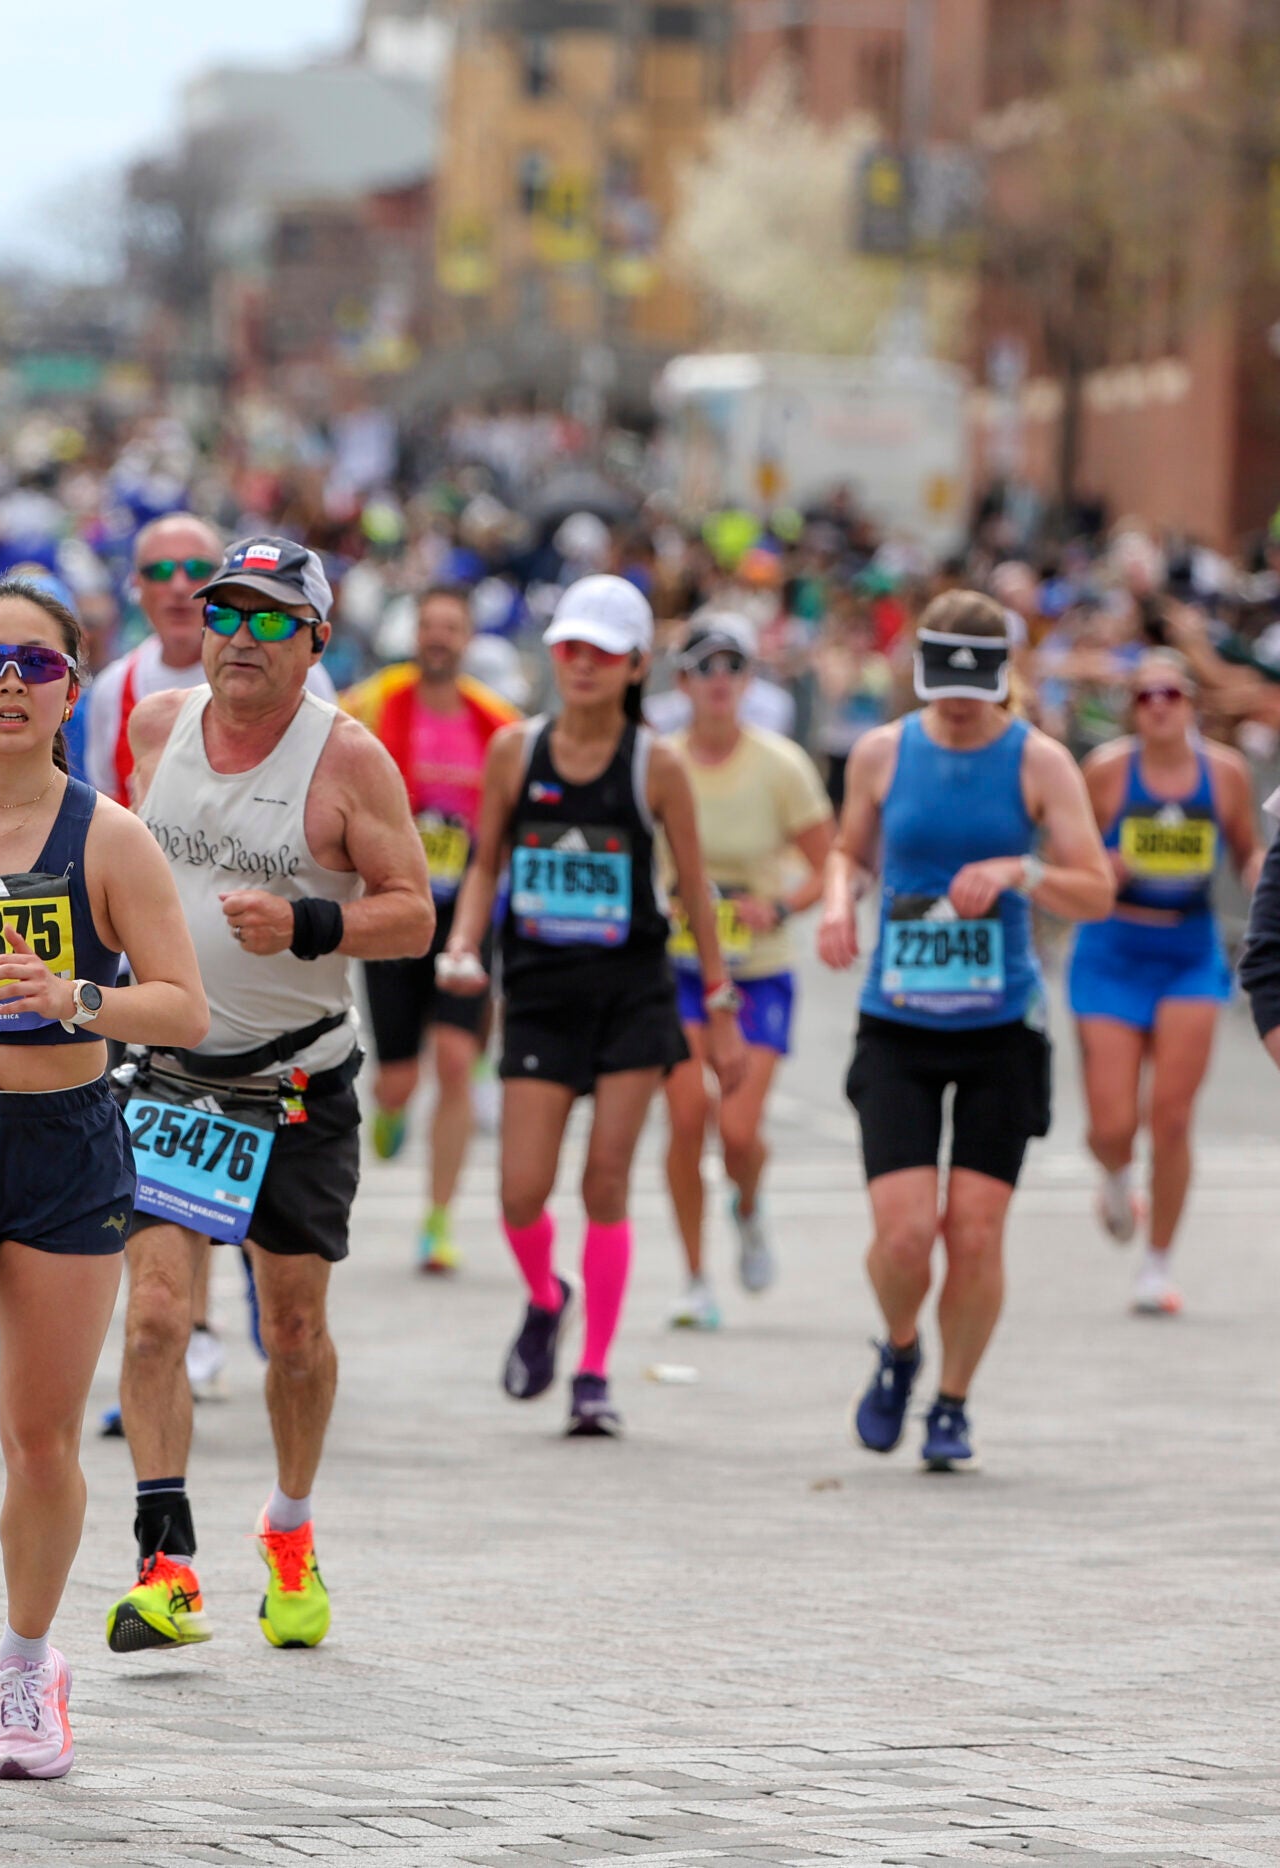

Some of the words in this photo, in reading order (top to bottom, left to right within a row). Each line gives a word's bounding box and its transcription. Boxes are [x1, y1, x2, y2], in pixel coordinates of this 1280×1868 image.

[248, 549, 277, 558] TEXAS
[220, 836, 300, 884] People
[893, 928, 993, 968] 22048
[131, 1105, 261, 1182] 25476
[157, 1189, 190, 1210] BOSTON
[188, 1202, 236, 1226] MARATHON
